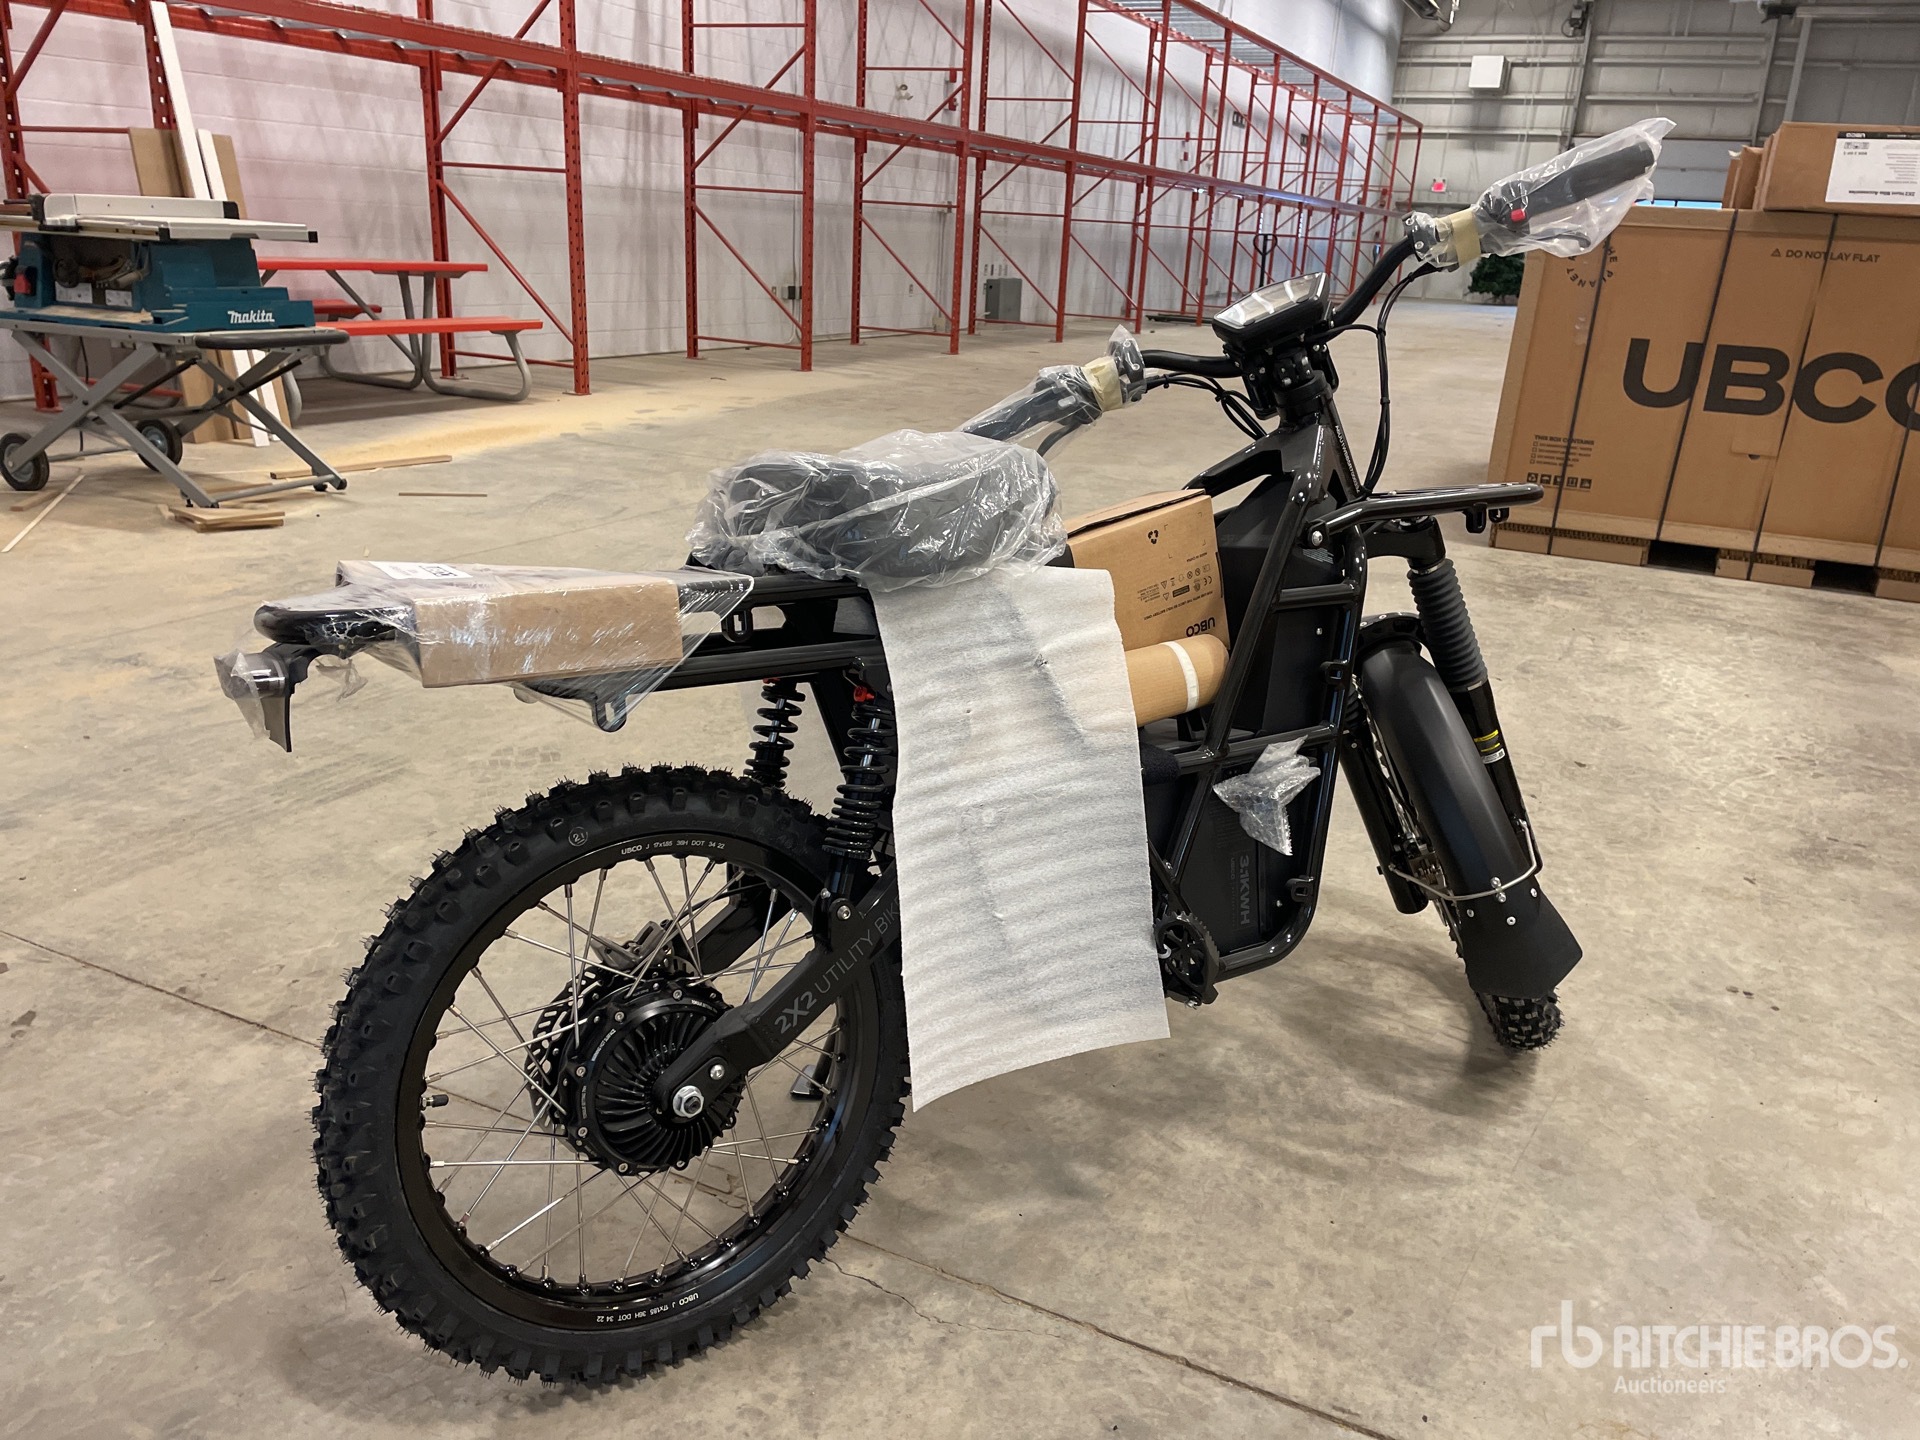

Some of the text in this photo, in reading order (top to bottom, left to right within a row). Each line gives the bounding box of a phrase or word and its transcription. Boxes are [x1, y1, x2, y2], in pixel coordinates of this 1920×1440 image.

[1785, 249, 1803, 258] DO
[1830, 252, 1852, 261] LAY
[1852, 253, 1881, 263] FLAT
[1186, 617, 1215, 637] UBCO
[621, 844, 642, 855] UBCO
[774, 990, 817, 1034] 2X2
[814, 929, 874, 994] UTILITY
[679, 1292, 699, 1306] UBCO
